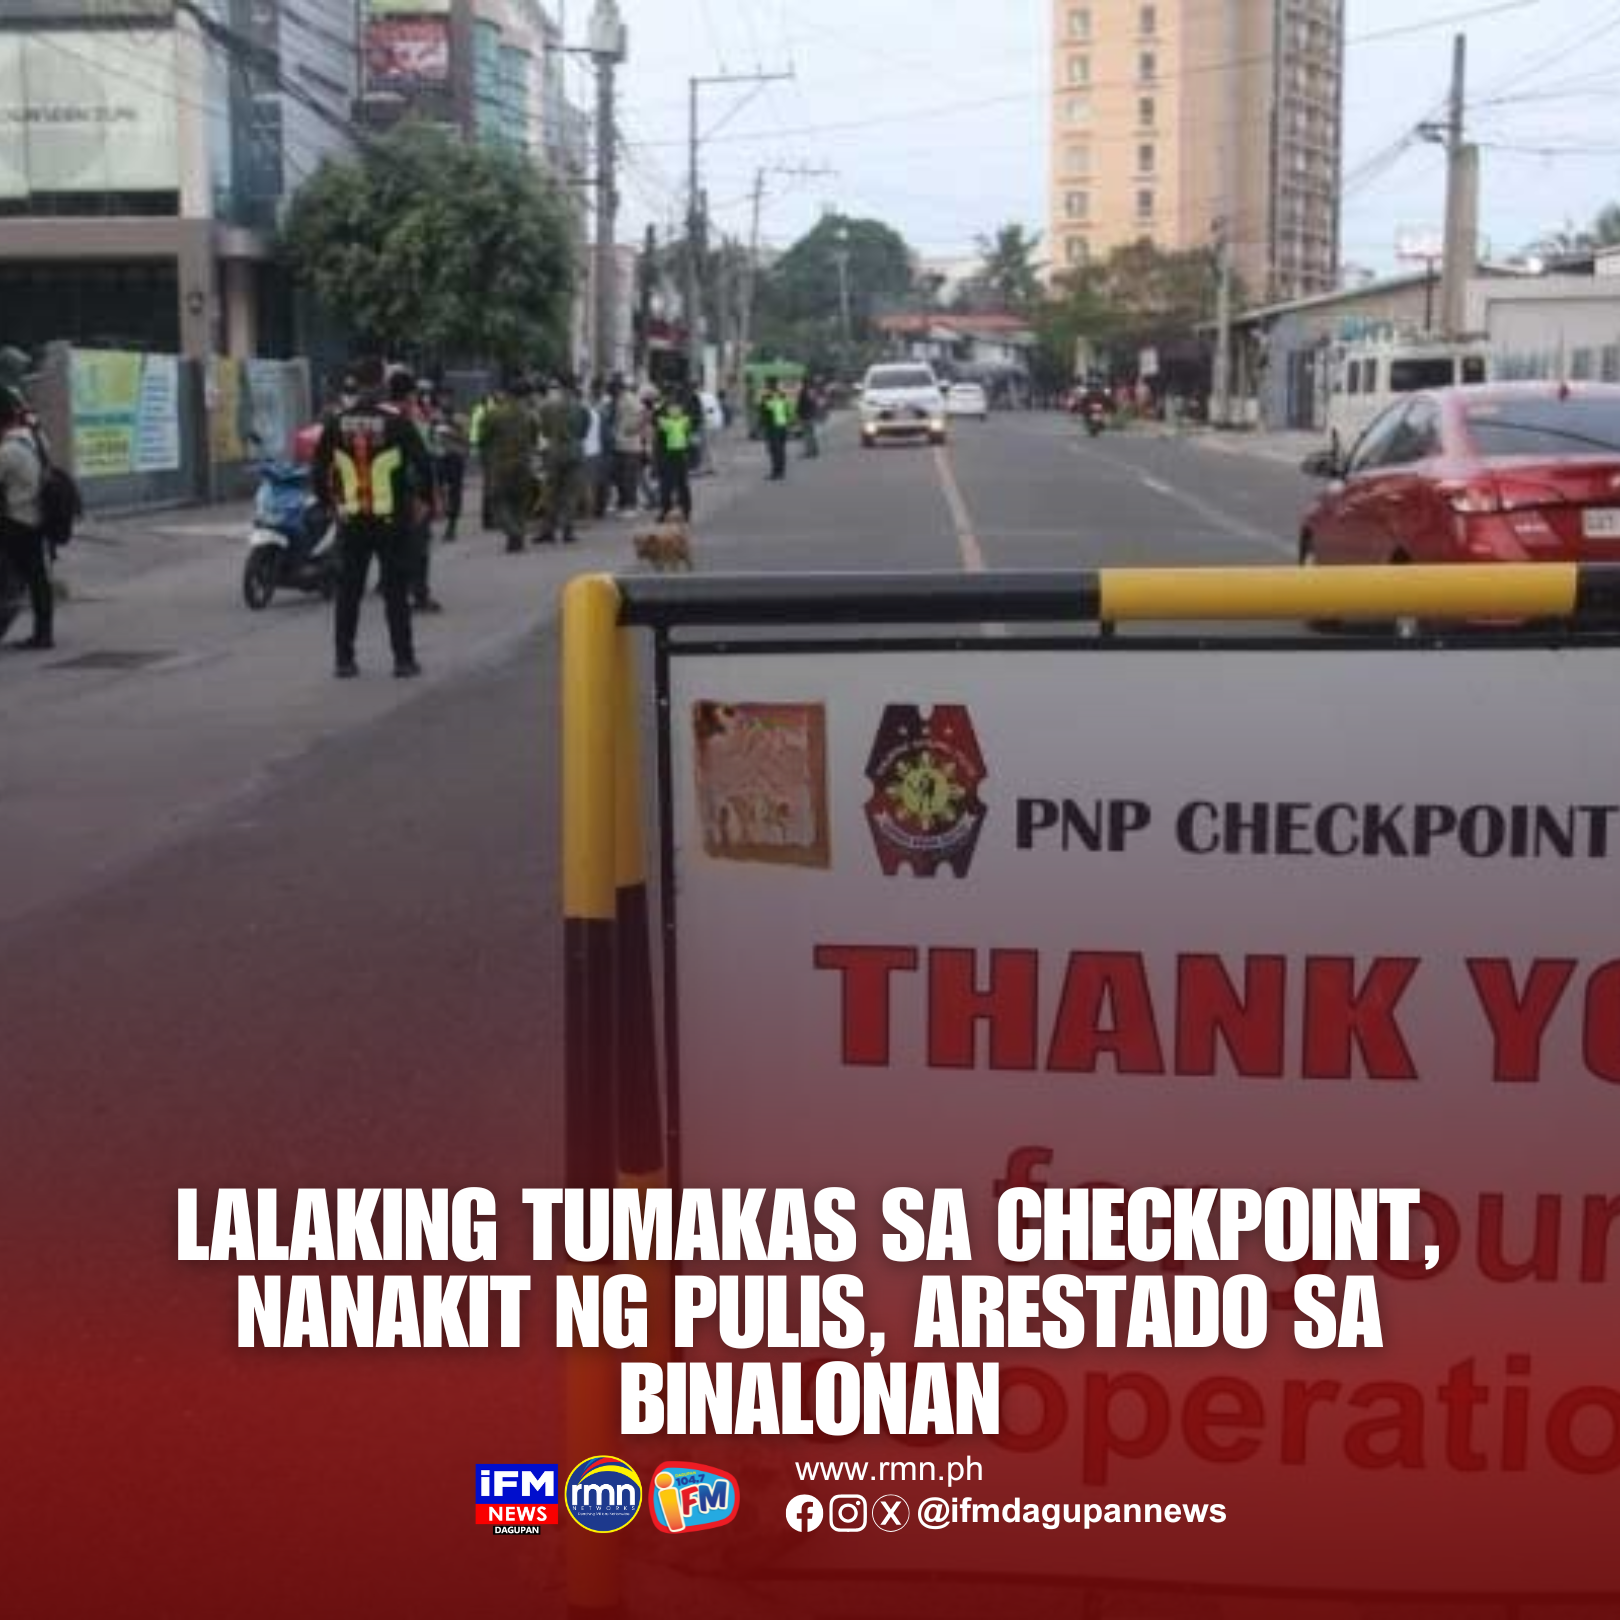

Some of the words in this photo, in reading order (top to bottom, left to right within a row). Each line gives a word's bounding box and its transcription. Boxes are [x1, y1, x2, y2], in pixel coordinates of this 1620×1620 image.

[1015, 797, 1151, 852] PNP
[1175, 801, 1619, 858] CHECKPOINT
[813, 944, 1421, 1081] THANK
